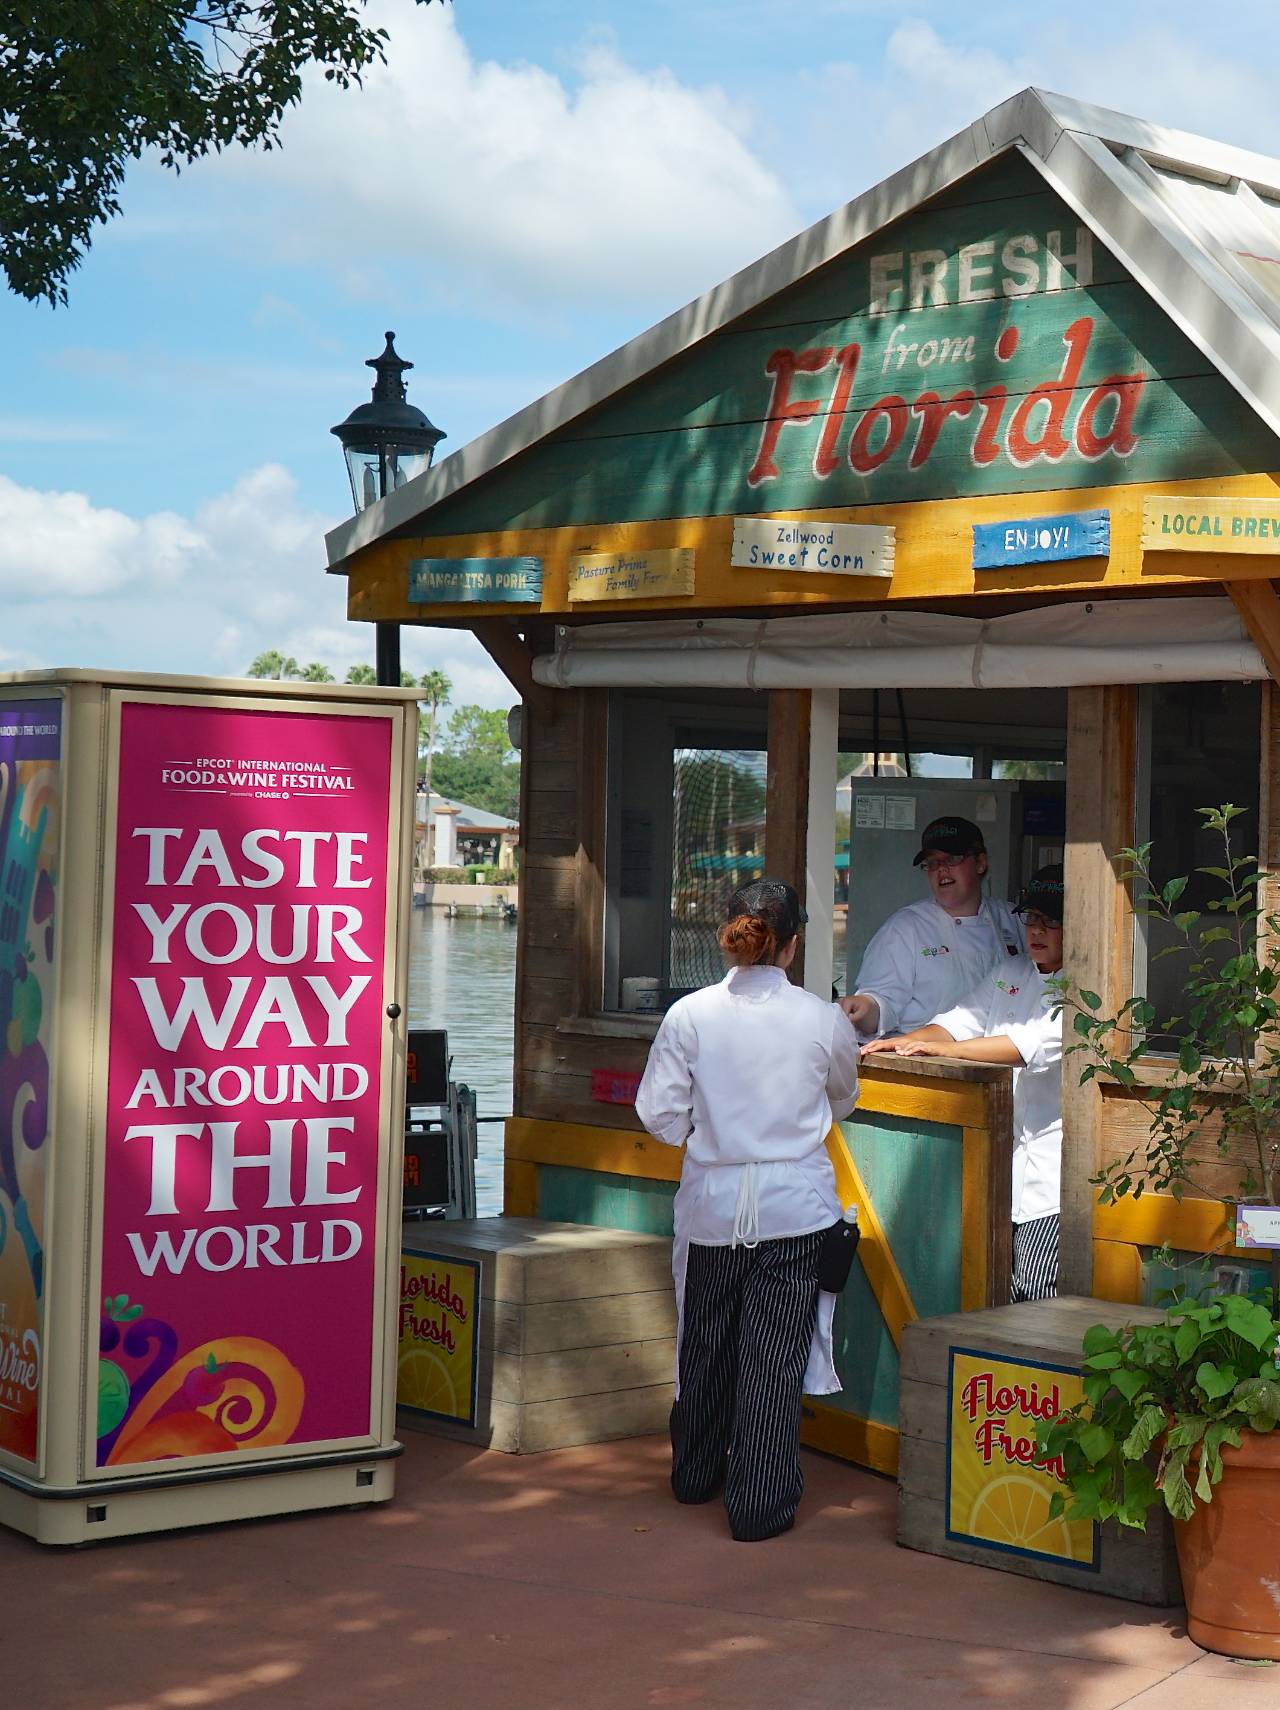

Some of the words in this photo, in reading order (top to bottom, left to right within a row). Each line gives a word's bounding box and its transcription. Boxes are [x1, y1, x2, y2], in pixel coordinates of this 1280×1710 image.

[868, 227, 1094, 319] FRESH
[880, 322, 977, 376] from
[746, 316, 1148, 489] Florida
[776, 527, 834, 545] Zellwood
[1004, 526, 1070, 551] ENJOY!
[1161, 514, 1223, 536] LOCAL
[577, 566, 616, 579] Pasture
[617, 558, 648, 572] Prime
[750, 545, 808, 566] Sweet
[817, 547, 864, 569] Corn
[495, 572, 527, 589] PORK
[606, 574, 640, 592] Family
[237, 759, 327, 773] INTERNATIONAL
[281, 774, 356, 790] FESTIVAL
[255, 791, 281, 799] CHASE
[131, 827, 373, 889] TASTE
[130, 902, 374, 965] YOUR
[129, 975, 373, 1052] WAY
[124, 1063, 369, 1109] AROUND
[123, 1116, 363, 1217] THE
[125, 1219, 363, 1277] WORLD
[400, 1265, 467, 1324] lorida
[962, 1372, 1070, 1424] Florid
